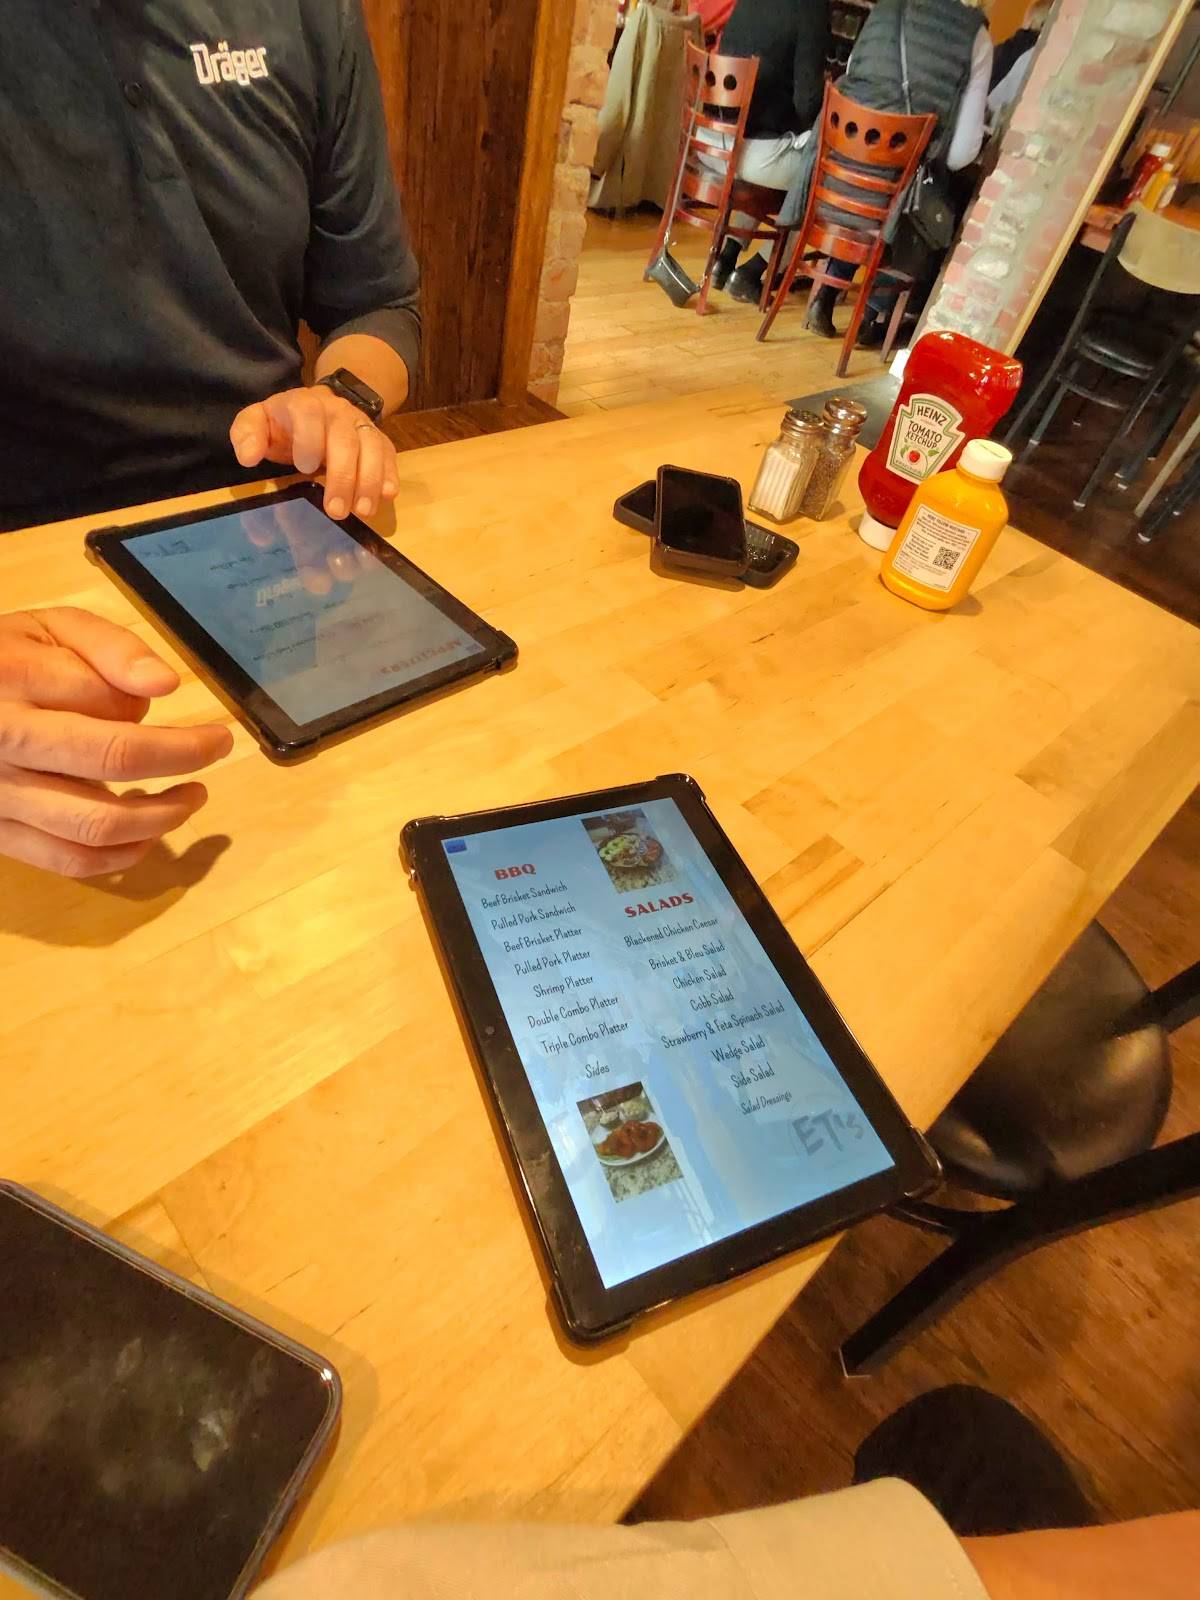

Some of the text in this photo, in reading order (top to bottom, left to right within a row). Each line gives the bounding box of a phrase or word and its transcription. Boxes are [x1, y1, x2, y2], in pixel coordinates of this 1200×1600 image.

[190, 41, 268, 86] Dräger
[916, 405, 948, 426] HEINZ
[905, 431, 938, 449] KETCHUP
[908, 420, 943, 443] TOMATO
[494, 863, 537, 880] BBQ
[481, 880, 568, 909] Beef Brisket Sandwich
[624, 892, 694, 918] SALADS
[491, 901, 577, 930] Pulled Pork Sandwich
[503, 927, 582, 952] Beef Brisket Platter
[623, 918, 719, 948] Blackened Chicken Caesar
[514, 950, 591, 976] Pulled Pork Platter
[648, 939, 726, 970] Brisket & Bleu Salad
[533, 975, 594, 998] Shrimp Platter
[672, 964, 727, 990] Chicken Salad
[527, 995, 619, 1028] Double Combo Platter
[689, 987, 735, 1012] Cobb Salad
[541, 1021, 629, 1054] Triple Combo Platter
[660, 1000, 785, 1049] Strawberry & Feta Spinach Salad
[711, 1034, 766, 1063] Wedge Salad
[585, 1060, 610, 1079] Sides
[730, 1061, 775, 1089] Side Salad
[740, 1099, 761, 1116] Salad
[791, 1108, 864, 1157] ET's
